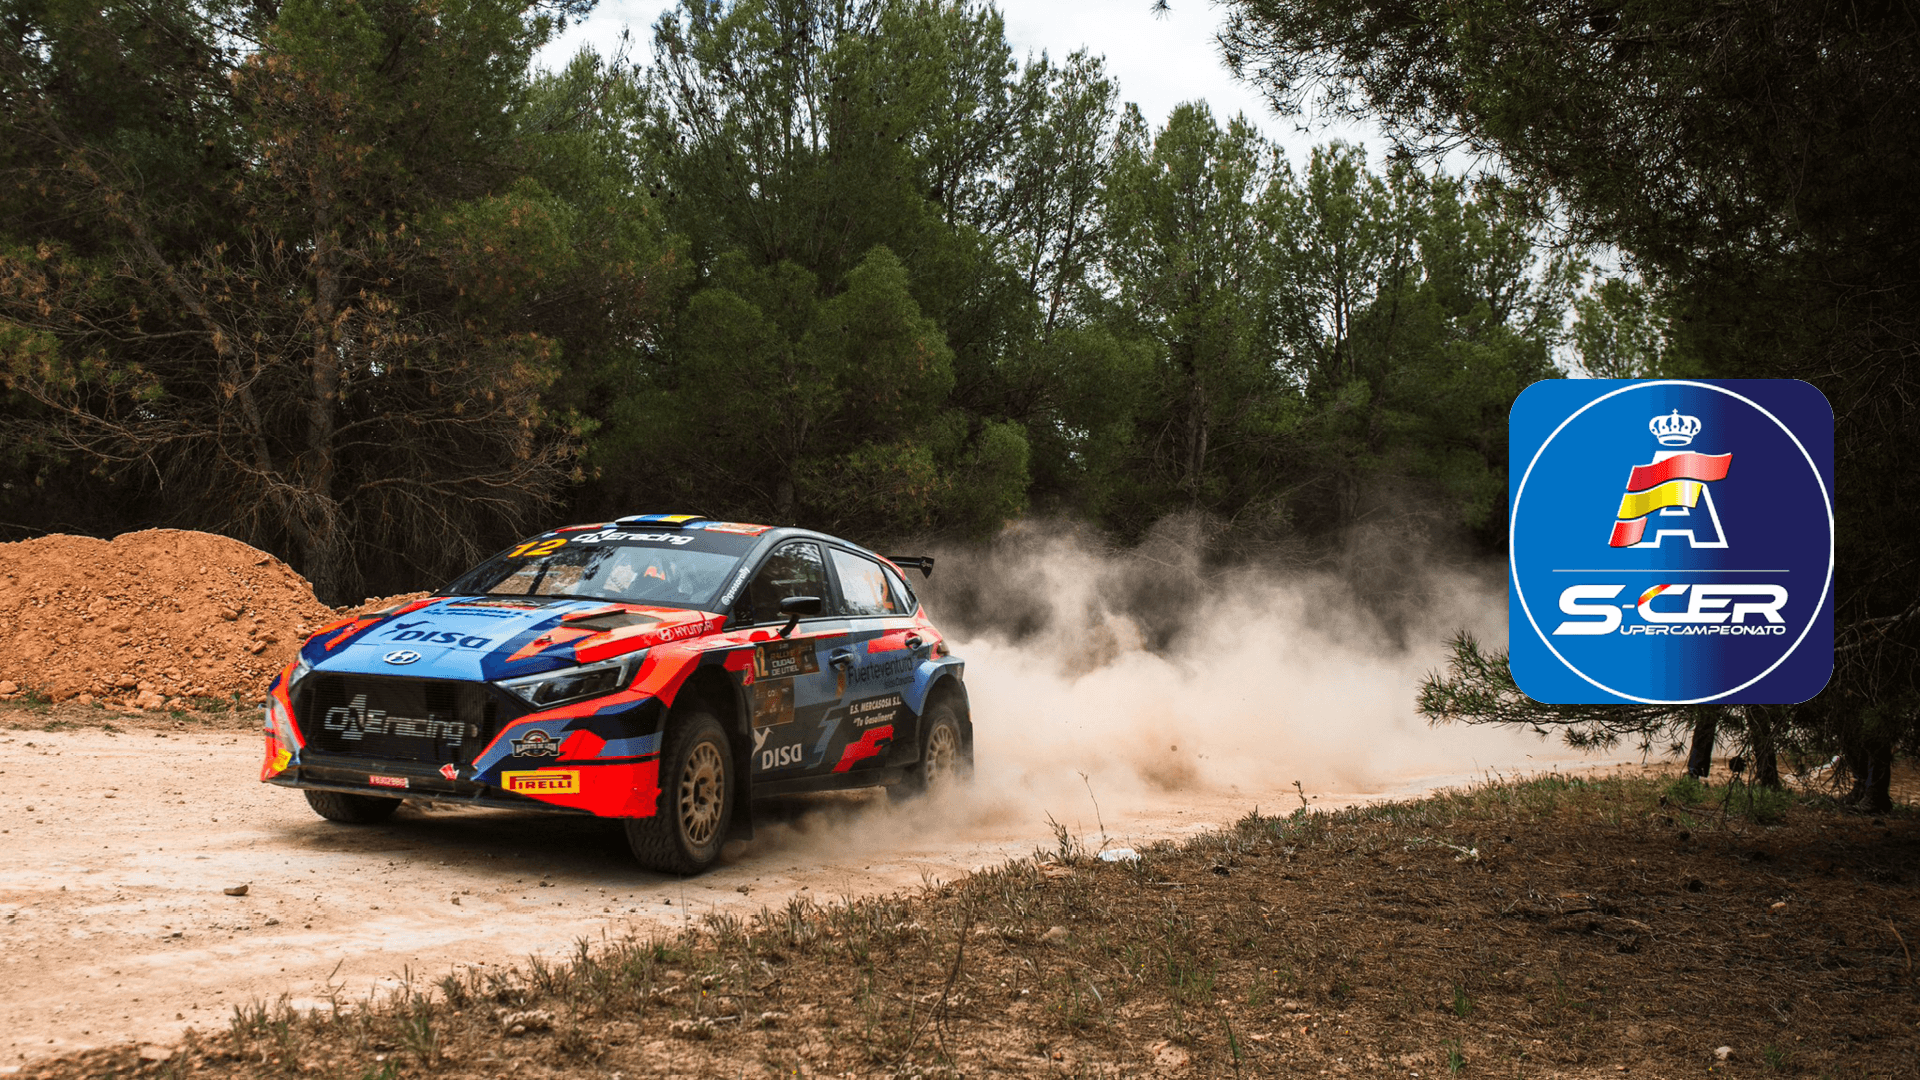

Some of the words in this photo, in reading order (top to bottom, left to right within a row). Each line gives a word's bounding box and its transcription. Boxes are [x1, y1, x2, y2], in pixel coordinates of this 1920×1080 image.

[508, 538, 568, 558] 12
[847, 657, 913, 685] Fuerteventura
[509, 774, 572, 790] PIRELLI
